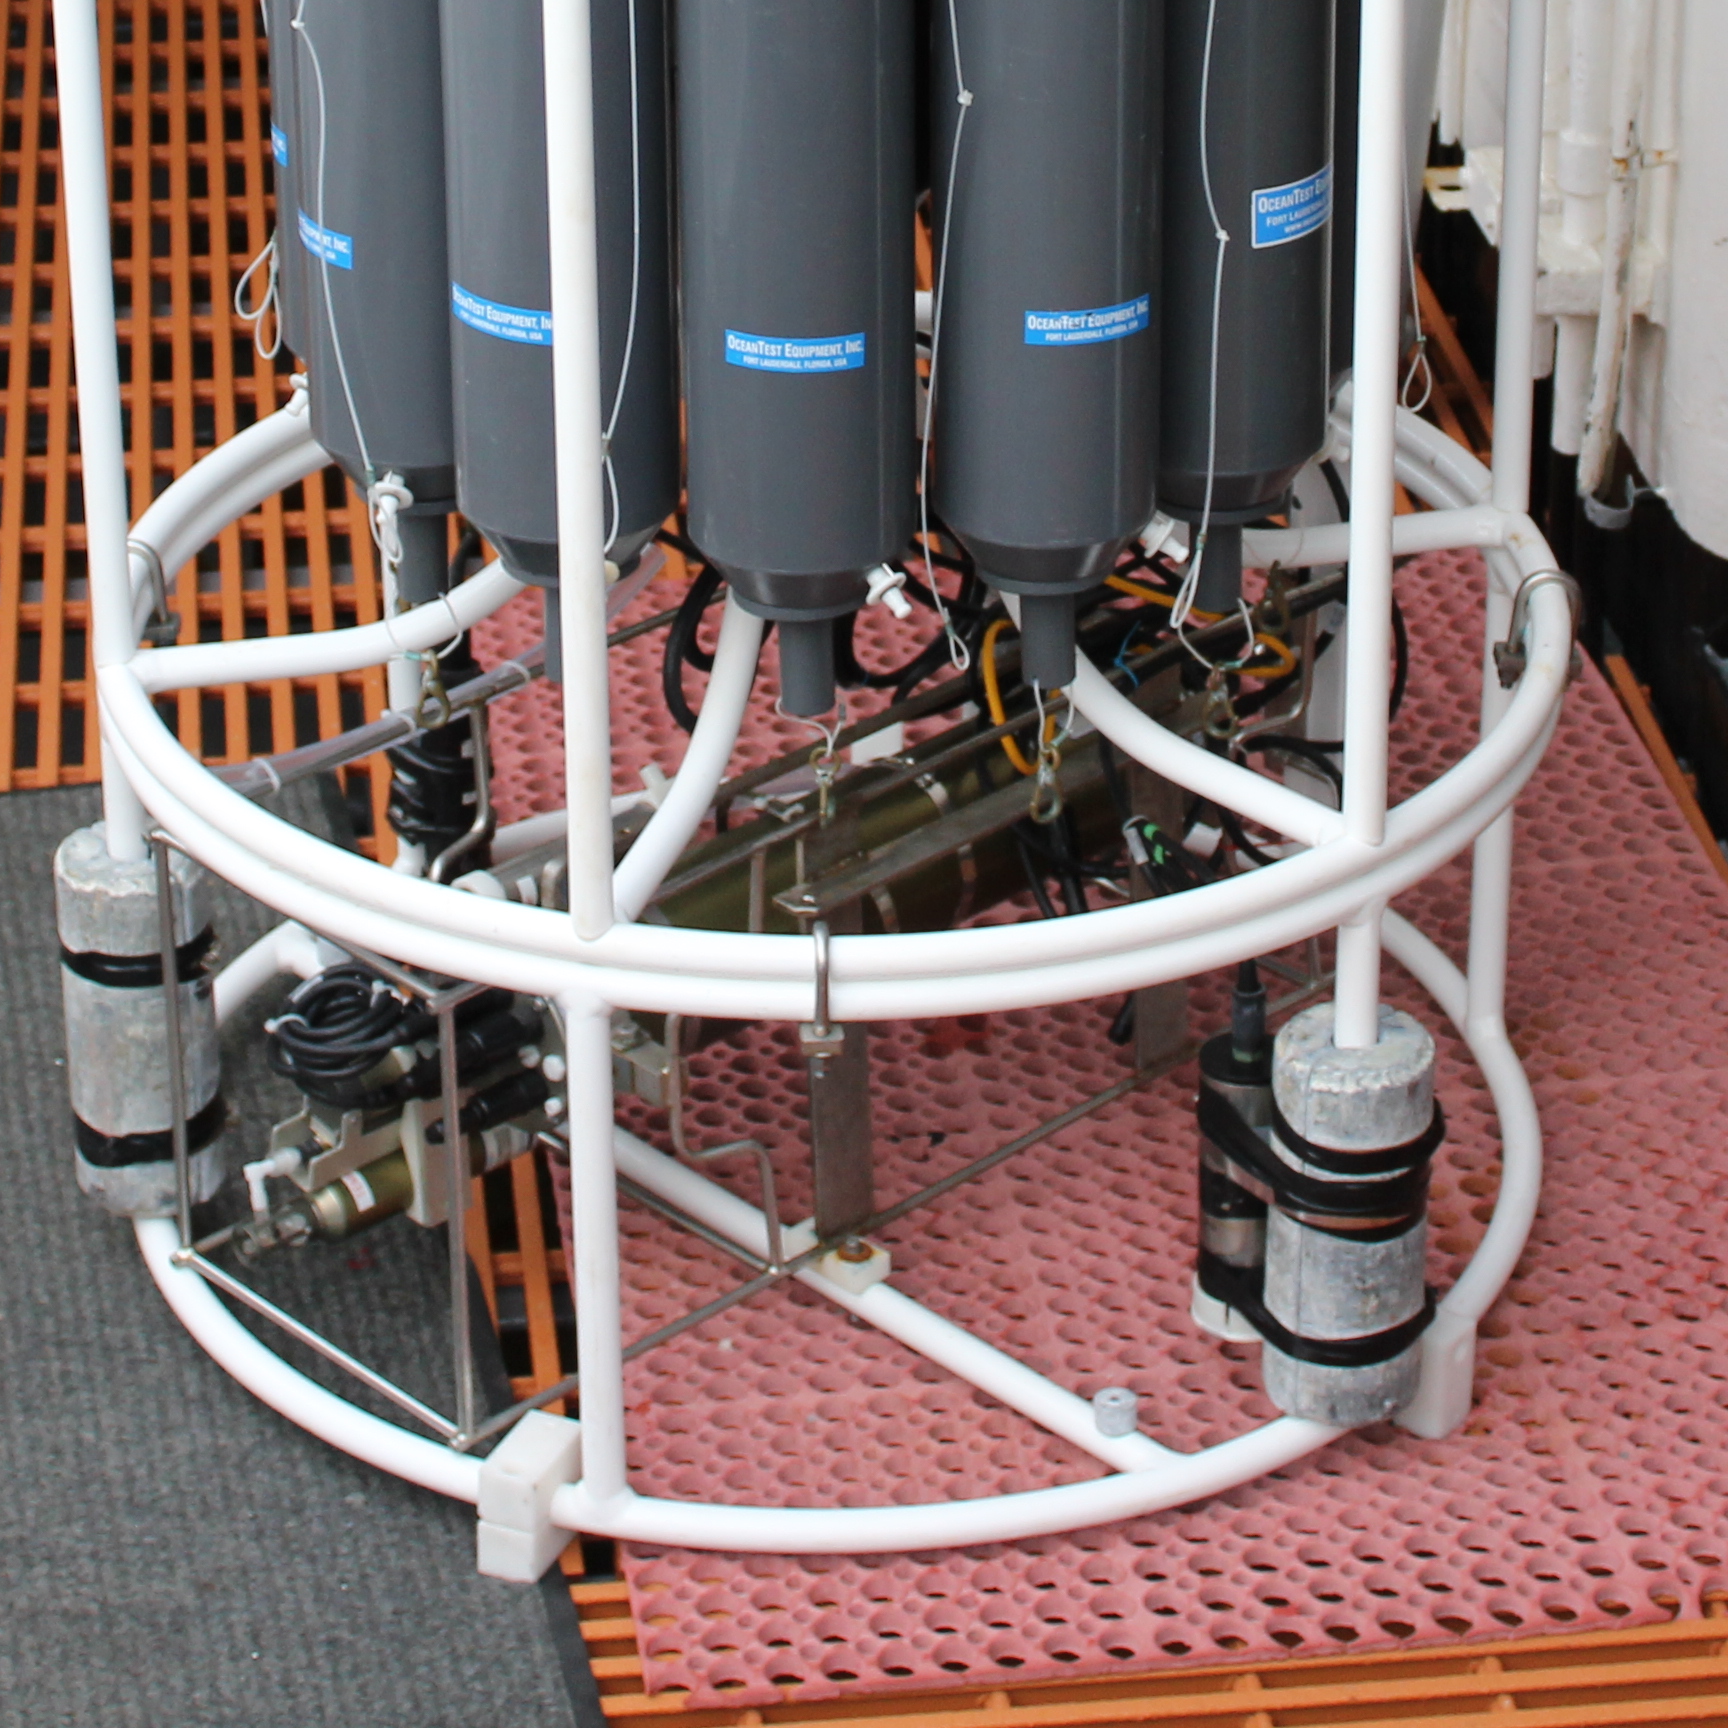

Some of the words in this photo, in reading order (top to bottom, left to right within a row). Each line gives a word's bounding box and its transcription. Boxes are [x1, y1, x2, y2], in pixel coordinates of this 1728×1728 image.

[1257, 184, 1316, 214] OCEANTEST
[540, 315, 552, 331] IN
[1026, 314, 1088, 331] OCEANTEST
[727, 334, 783, 357] OCEANTEST
[784, 342, 844, 359] EQUIPMENT,
[845, 339, 864, 354] INC.
